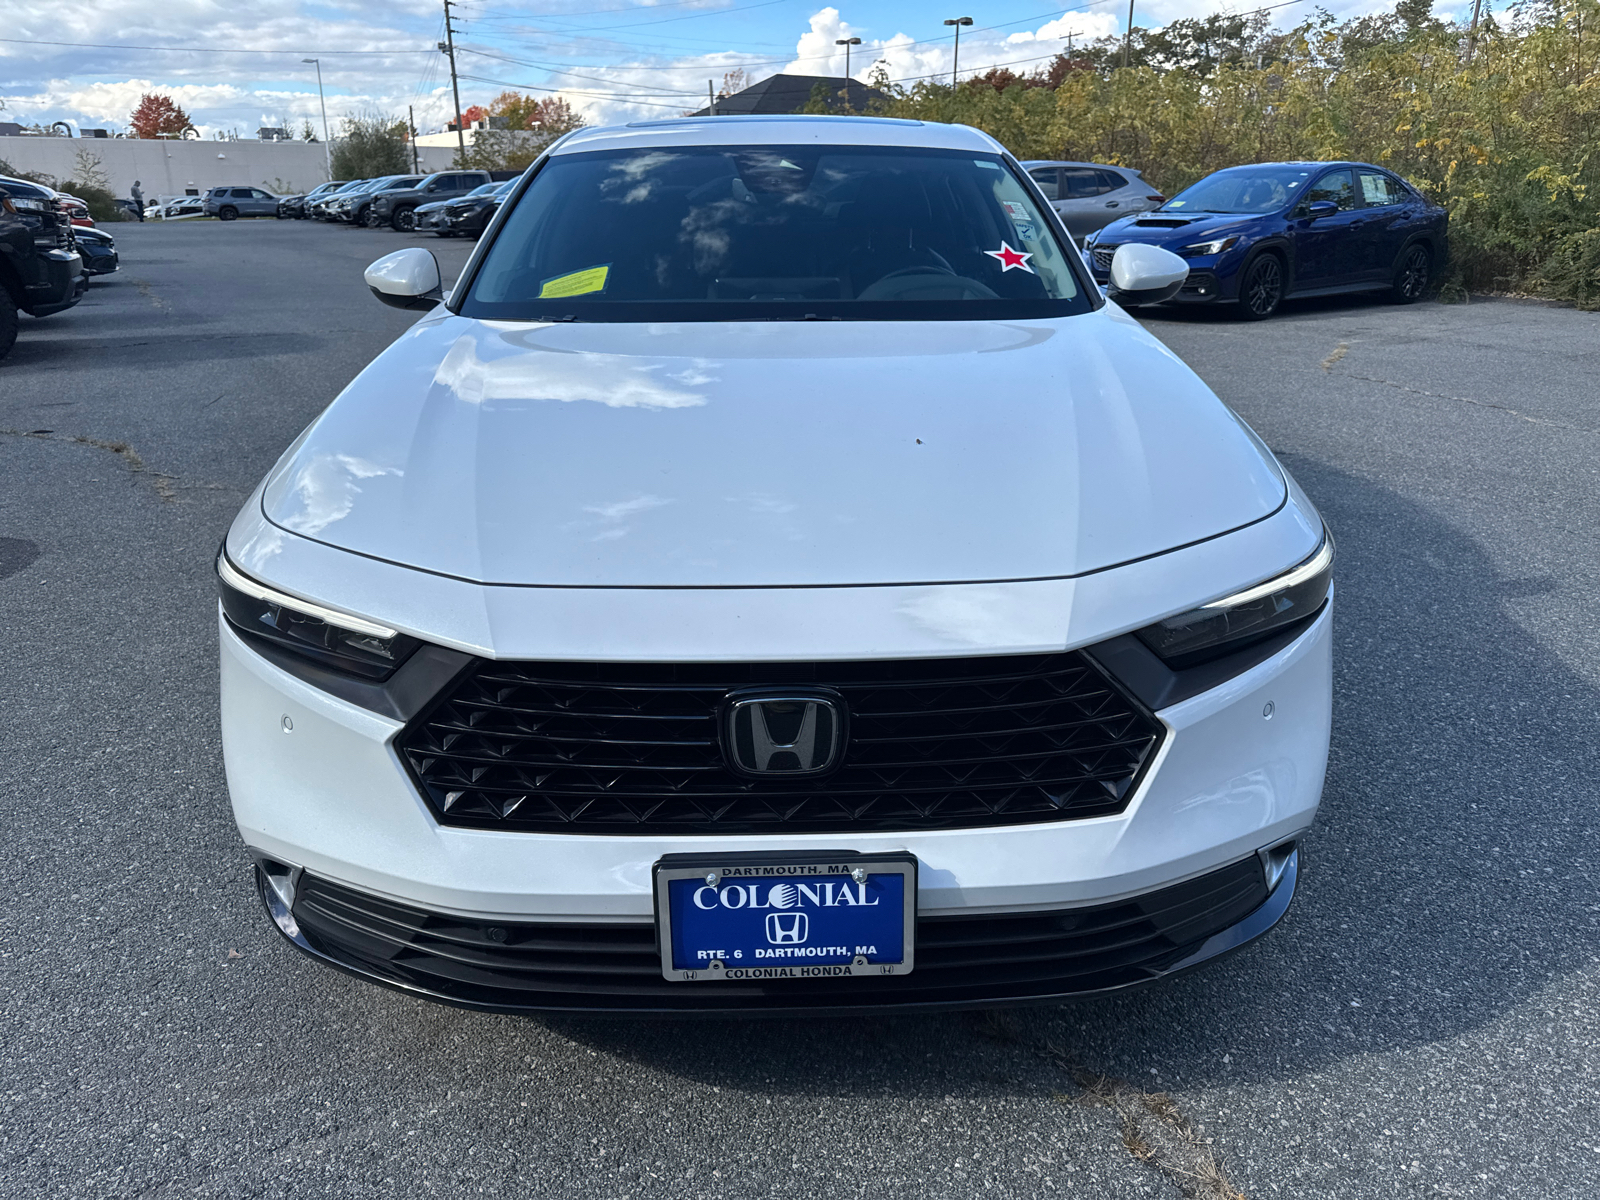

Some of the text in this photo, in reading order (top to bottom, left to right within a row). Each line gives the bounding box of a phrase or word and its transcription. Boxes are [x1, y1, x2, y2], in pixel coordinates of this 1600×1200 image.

[722, 864, 850, 876] DARTMOUTH, MA
[693, 882, 880, 910] COLONIAL
[697, 945, 878, 960] RTE. 6 DARTMOUTH, MA
[725, 966, 852, 979] COLONIAL HONDA
